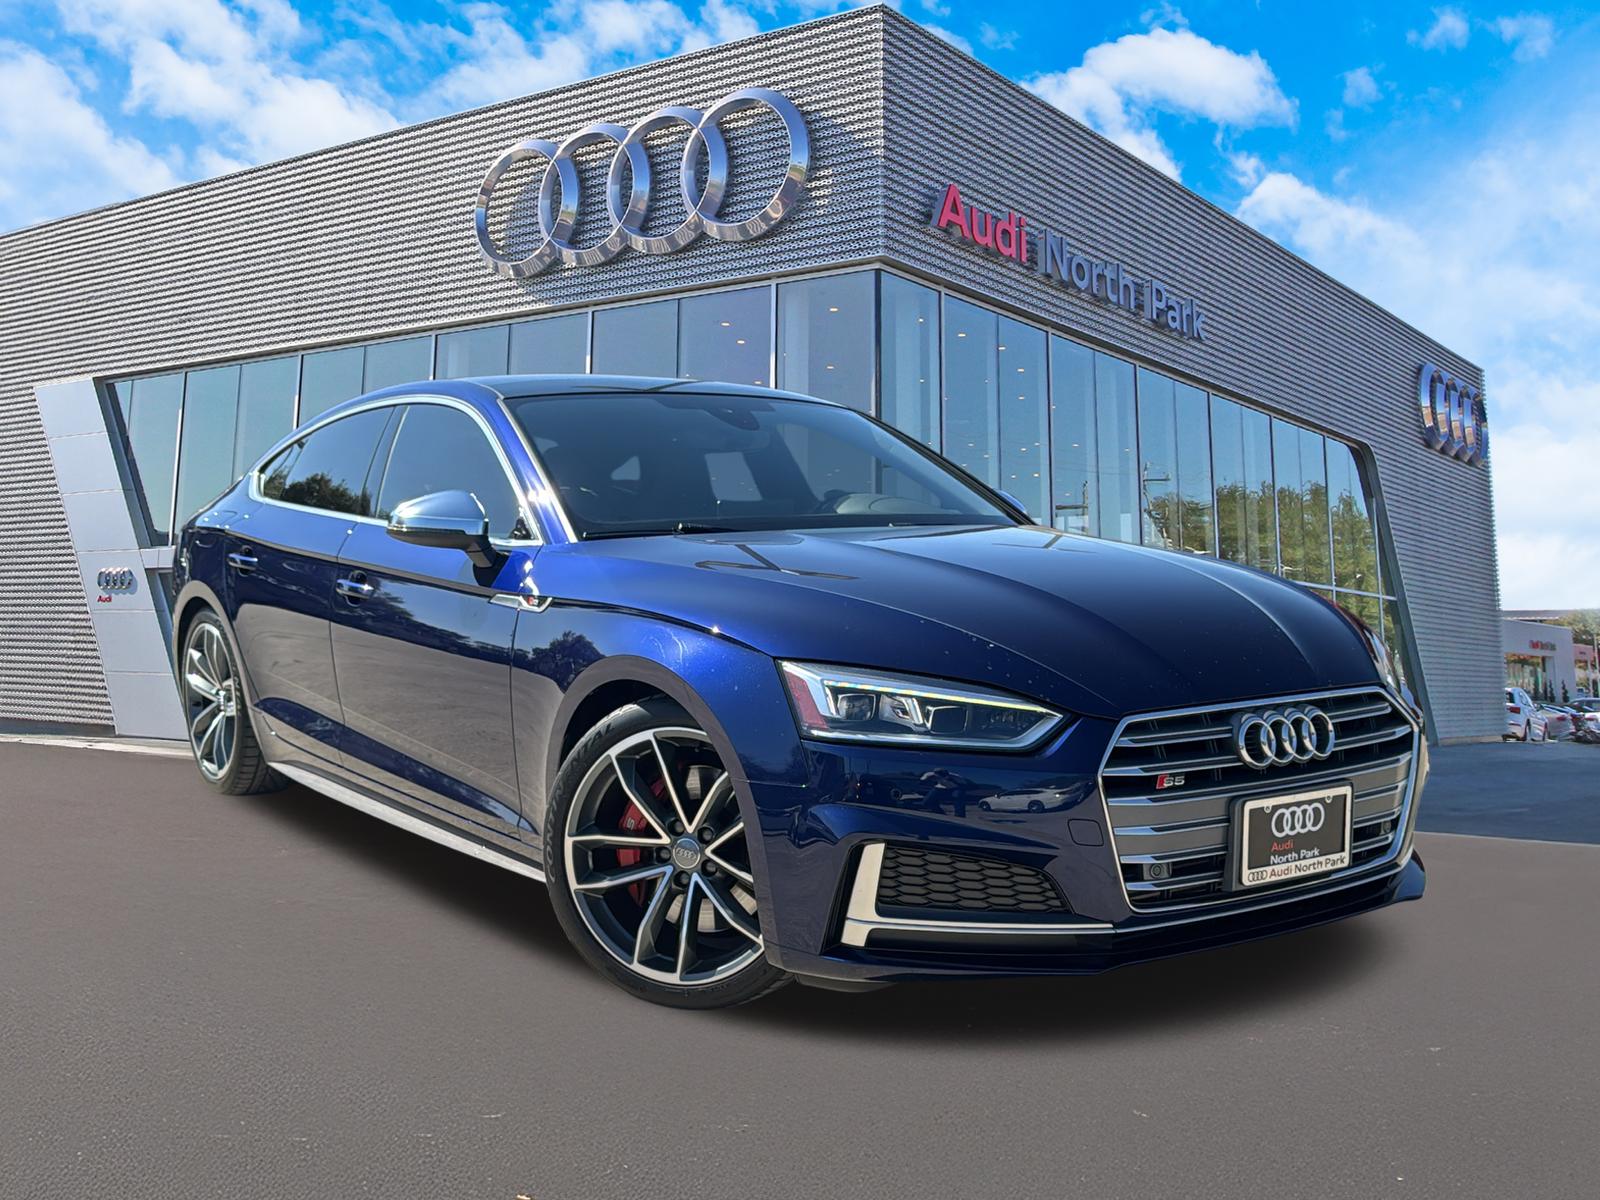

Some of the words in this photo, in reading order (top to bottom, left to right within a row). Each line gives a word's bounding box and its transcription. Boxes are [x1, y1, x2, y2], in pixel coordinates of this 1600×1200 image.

[937, 184, 1028, 263] Audi
[1044, 229, 1136, 309] North
[1151, 279, 1206, 341] Park
[1162, 774, 1185, 788] S5
[1271, 839, 1294, 852] Audi
[1270, 851, 1298, 865] North
[1300, 847, 1320, 859] Park
[1269, 866, 1292, 879] Audi
[1294, 861, 1323, 874] North
[1324, 855, 1346, 868] Park
